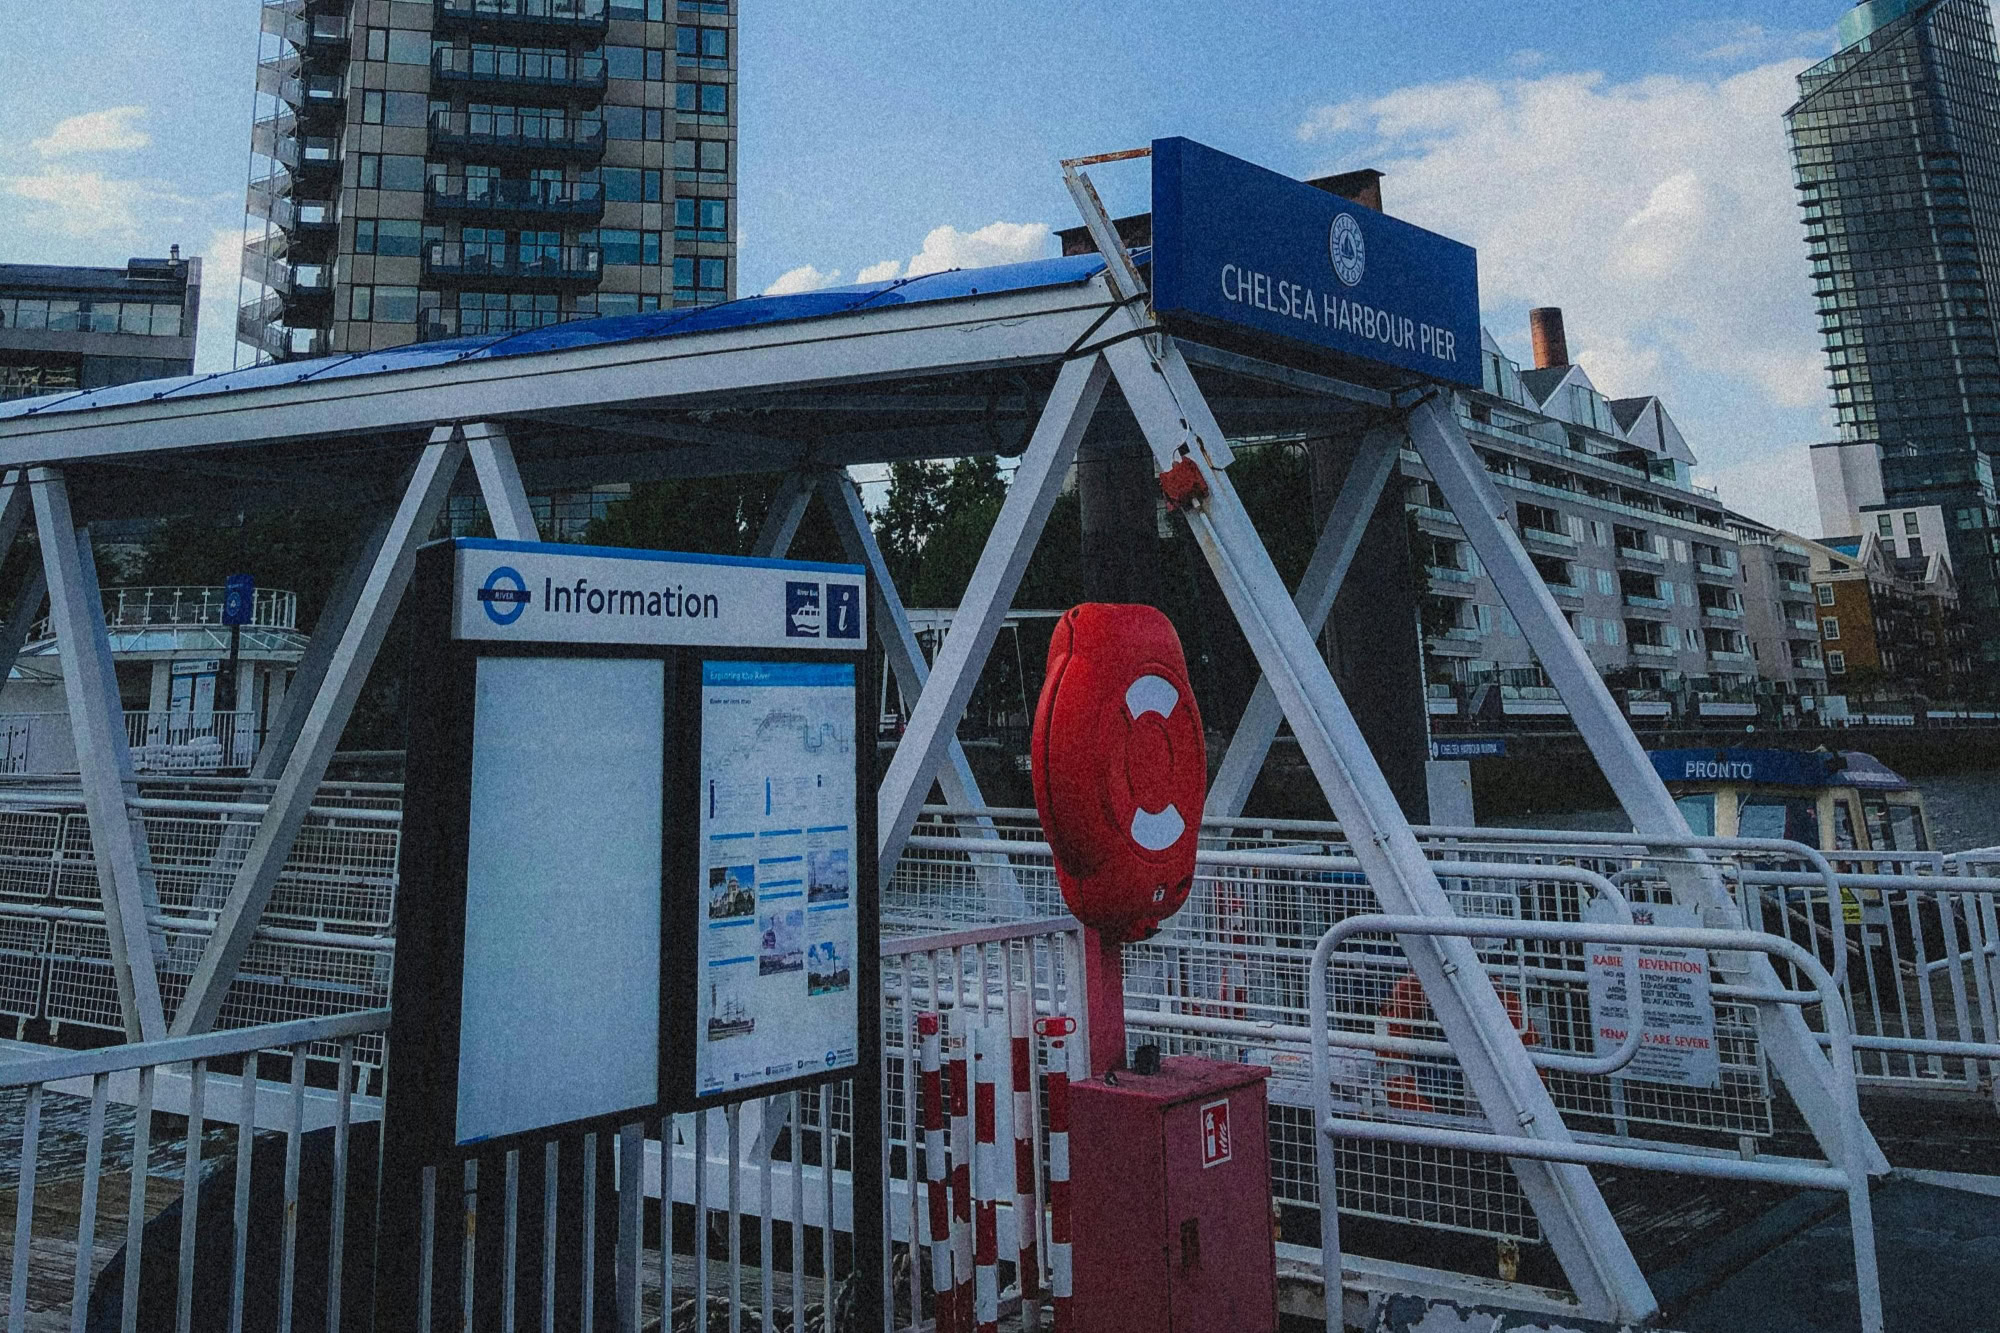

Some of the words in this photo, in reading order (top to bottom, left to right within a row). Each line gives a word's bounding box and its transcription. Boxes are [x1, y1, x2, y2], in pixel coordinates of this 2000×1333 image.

[1221, 263, 1318, 324] CHELSEA
[1324, 293, 1415, 351] HARBOUR
[1420, 323, 1457, 362] PIER
[495, 592, 514, 600] RIVER
[545, 577, 719, 618] Information
[1685, 760, 1752, 779] PRONTO
[1593, 954, 1623, 967] RABIE
[1638, 958, 1702, 974] REVENTION
[1653, 1034, 1671, 1045] ARE
[1675, 1035, 1710, 1049] SEVERE
